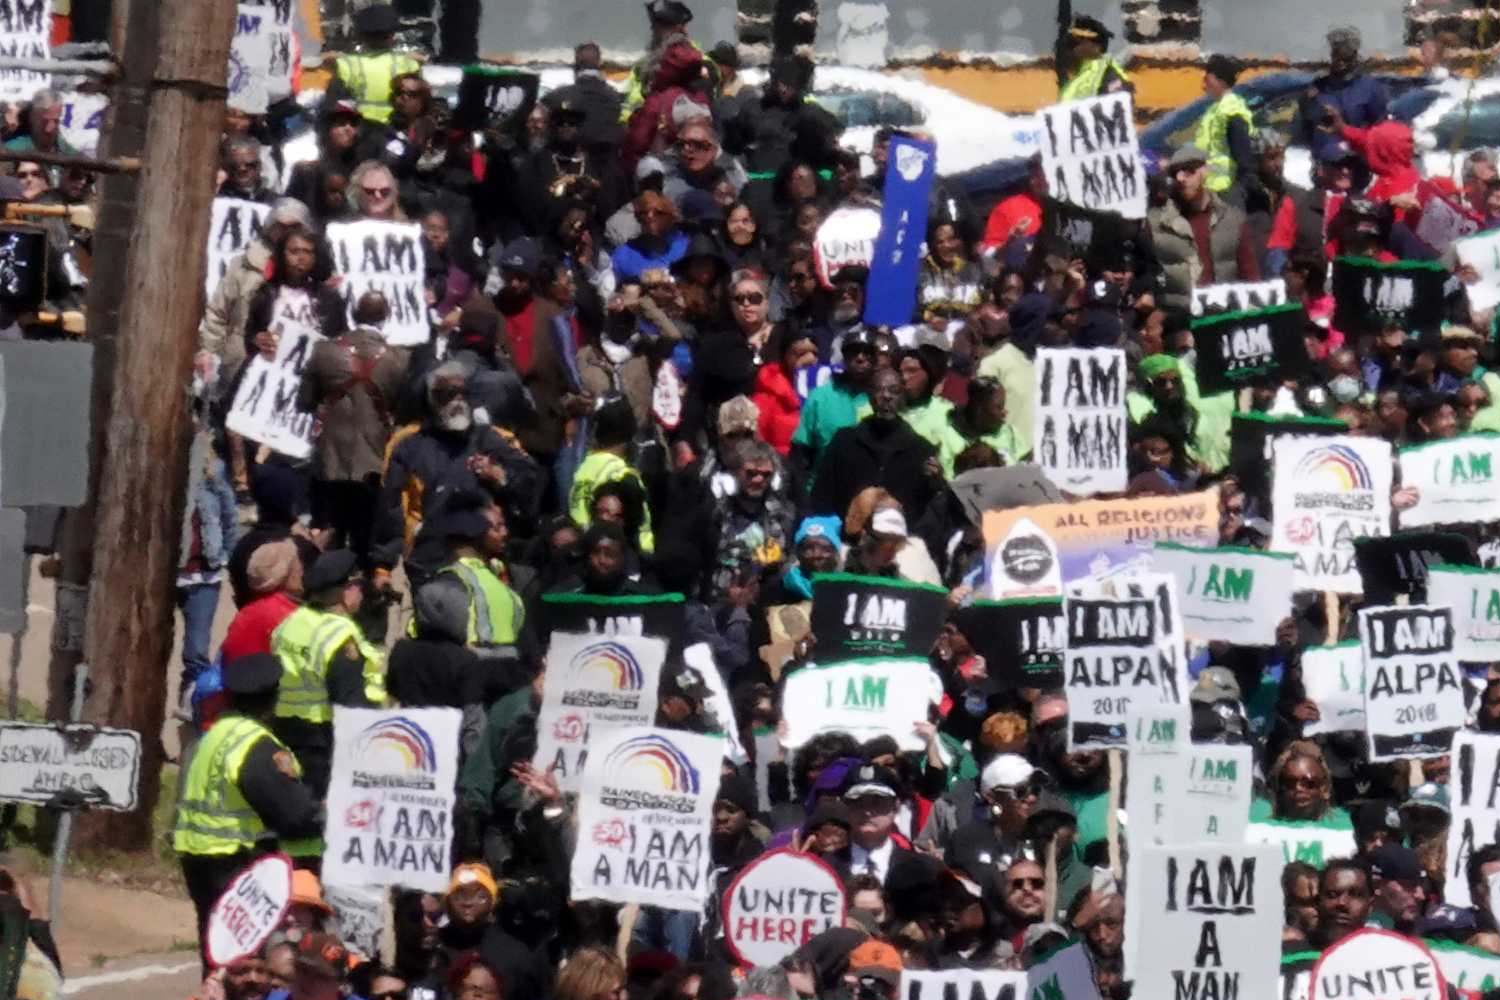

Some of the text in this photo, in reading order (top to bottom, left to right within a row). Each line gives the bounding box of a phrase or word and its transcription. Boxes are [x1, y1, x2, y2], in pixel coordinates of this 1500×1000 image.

[1046, 103, 1131, 157] I AM
[1055, 153, 1138, 206] A MAN
[363, 235, 417, 275] AM
[1221, 324, 1273, 358] I AM
[1041, 354, 1122, 406] I AM
[1040, 414, 1122, 469] A MAN
[1451, 453, 1492, 480] AM
[1056, 505, 1206, 528] ALL RELIGIONS
[1205, 567, 1254, 599] AM
[844, 594, 906, 631] I AM
[1076, 605, 1147, 638] I AM
[1021, 620, 1029, 650] I
[1373, 617, 1446, 650] I AM
[1069, 656, 1156, 688] ALPA
[1369, 664, 1458, 697] ALPA
[845, 676, 889, 709] AM
[1148, 718, 1176, 739] AM
[1203, 758, 1237, 780] AM
[1460, 744, 1475, 806] I
[394, 809, 447, 839] AM
[344, 838, 445, 873] A MAN
[629, 825, 701, 860] I AM
[593, 854, 700, 890] A MAN
[1167, 855, 1256, 912] I AM
[237, 874, 280, 925] UNITE
[738, 887, 838, 916] UNITE
[1195, 920, 1222, 968] A
[1322, 961, 1432, 1000] UNITE
